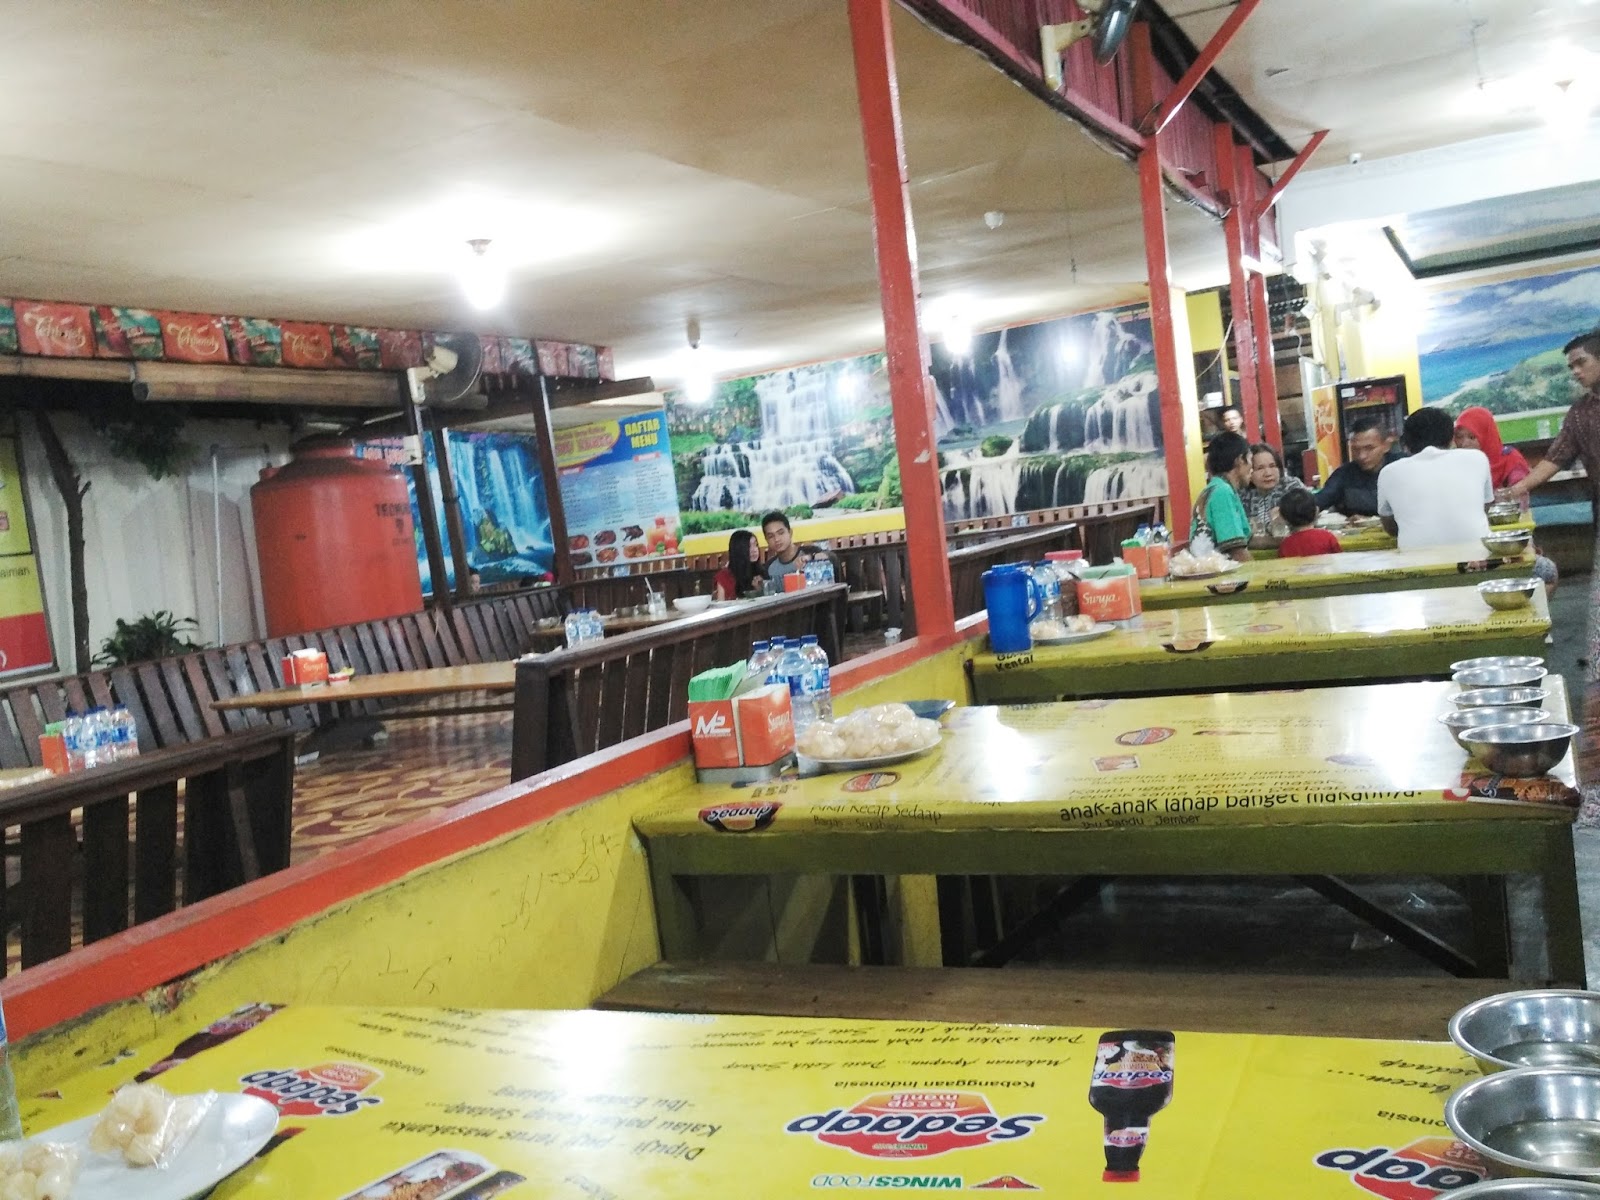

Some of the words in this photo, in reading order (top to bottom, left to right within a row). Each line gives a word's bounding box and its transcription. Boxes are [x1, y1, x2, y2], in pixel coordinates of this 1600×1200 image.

[625, 418, 660, 436] DAFTAR
[631, 432, 658, 448] MENU
[1082, 592, 1116, 608] Surya
[995, 654, 1034, 672] Kental
[894, 803, 942, 825] Sedaap
[1155, 814, 1201, 825] Jember
[931, 1036, 960, 1044] aja
[1029, 1034, 1085, 1045] Pakai
[986, 1057, 1071, 1068] Makanan
[1379, 1059, 1479, 1077] sedaap
[1094, 1070, 1173, 1082] Sedaap
[241, 1069, 382, 1116] Sedaap
[834, 1081, 918, 1089] Indonesia
[924, 1080, 1036, 1090] Kebanggaan
[887, 1099, 957, 1109] kecap
[891, 1094, 959, 1102] manis
[786, 1110, 1044, 1139] Sedaap
[1376, 1110, 1448, 1127] onesia
[379, 1121, 497, 1139] masakanku
[657, 1121, 722, 1138] Kalau
[630, 1140, 706, 1162] Dipuji
